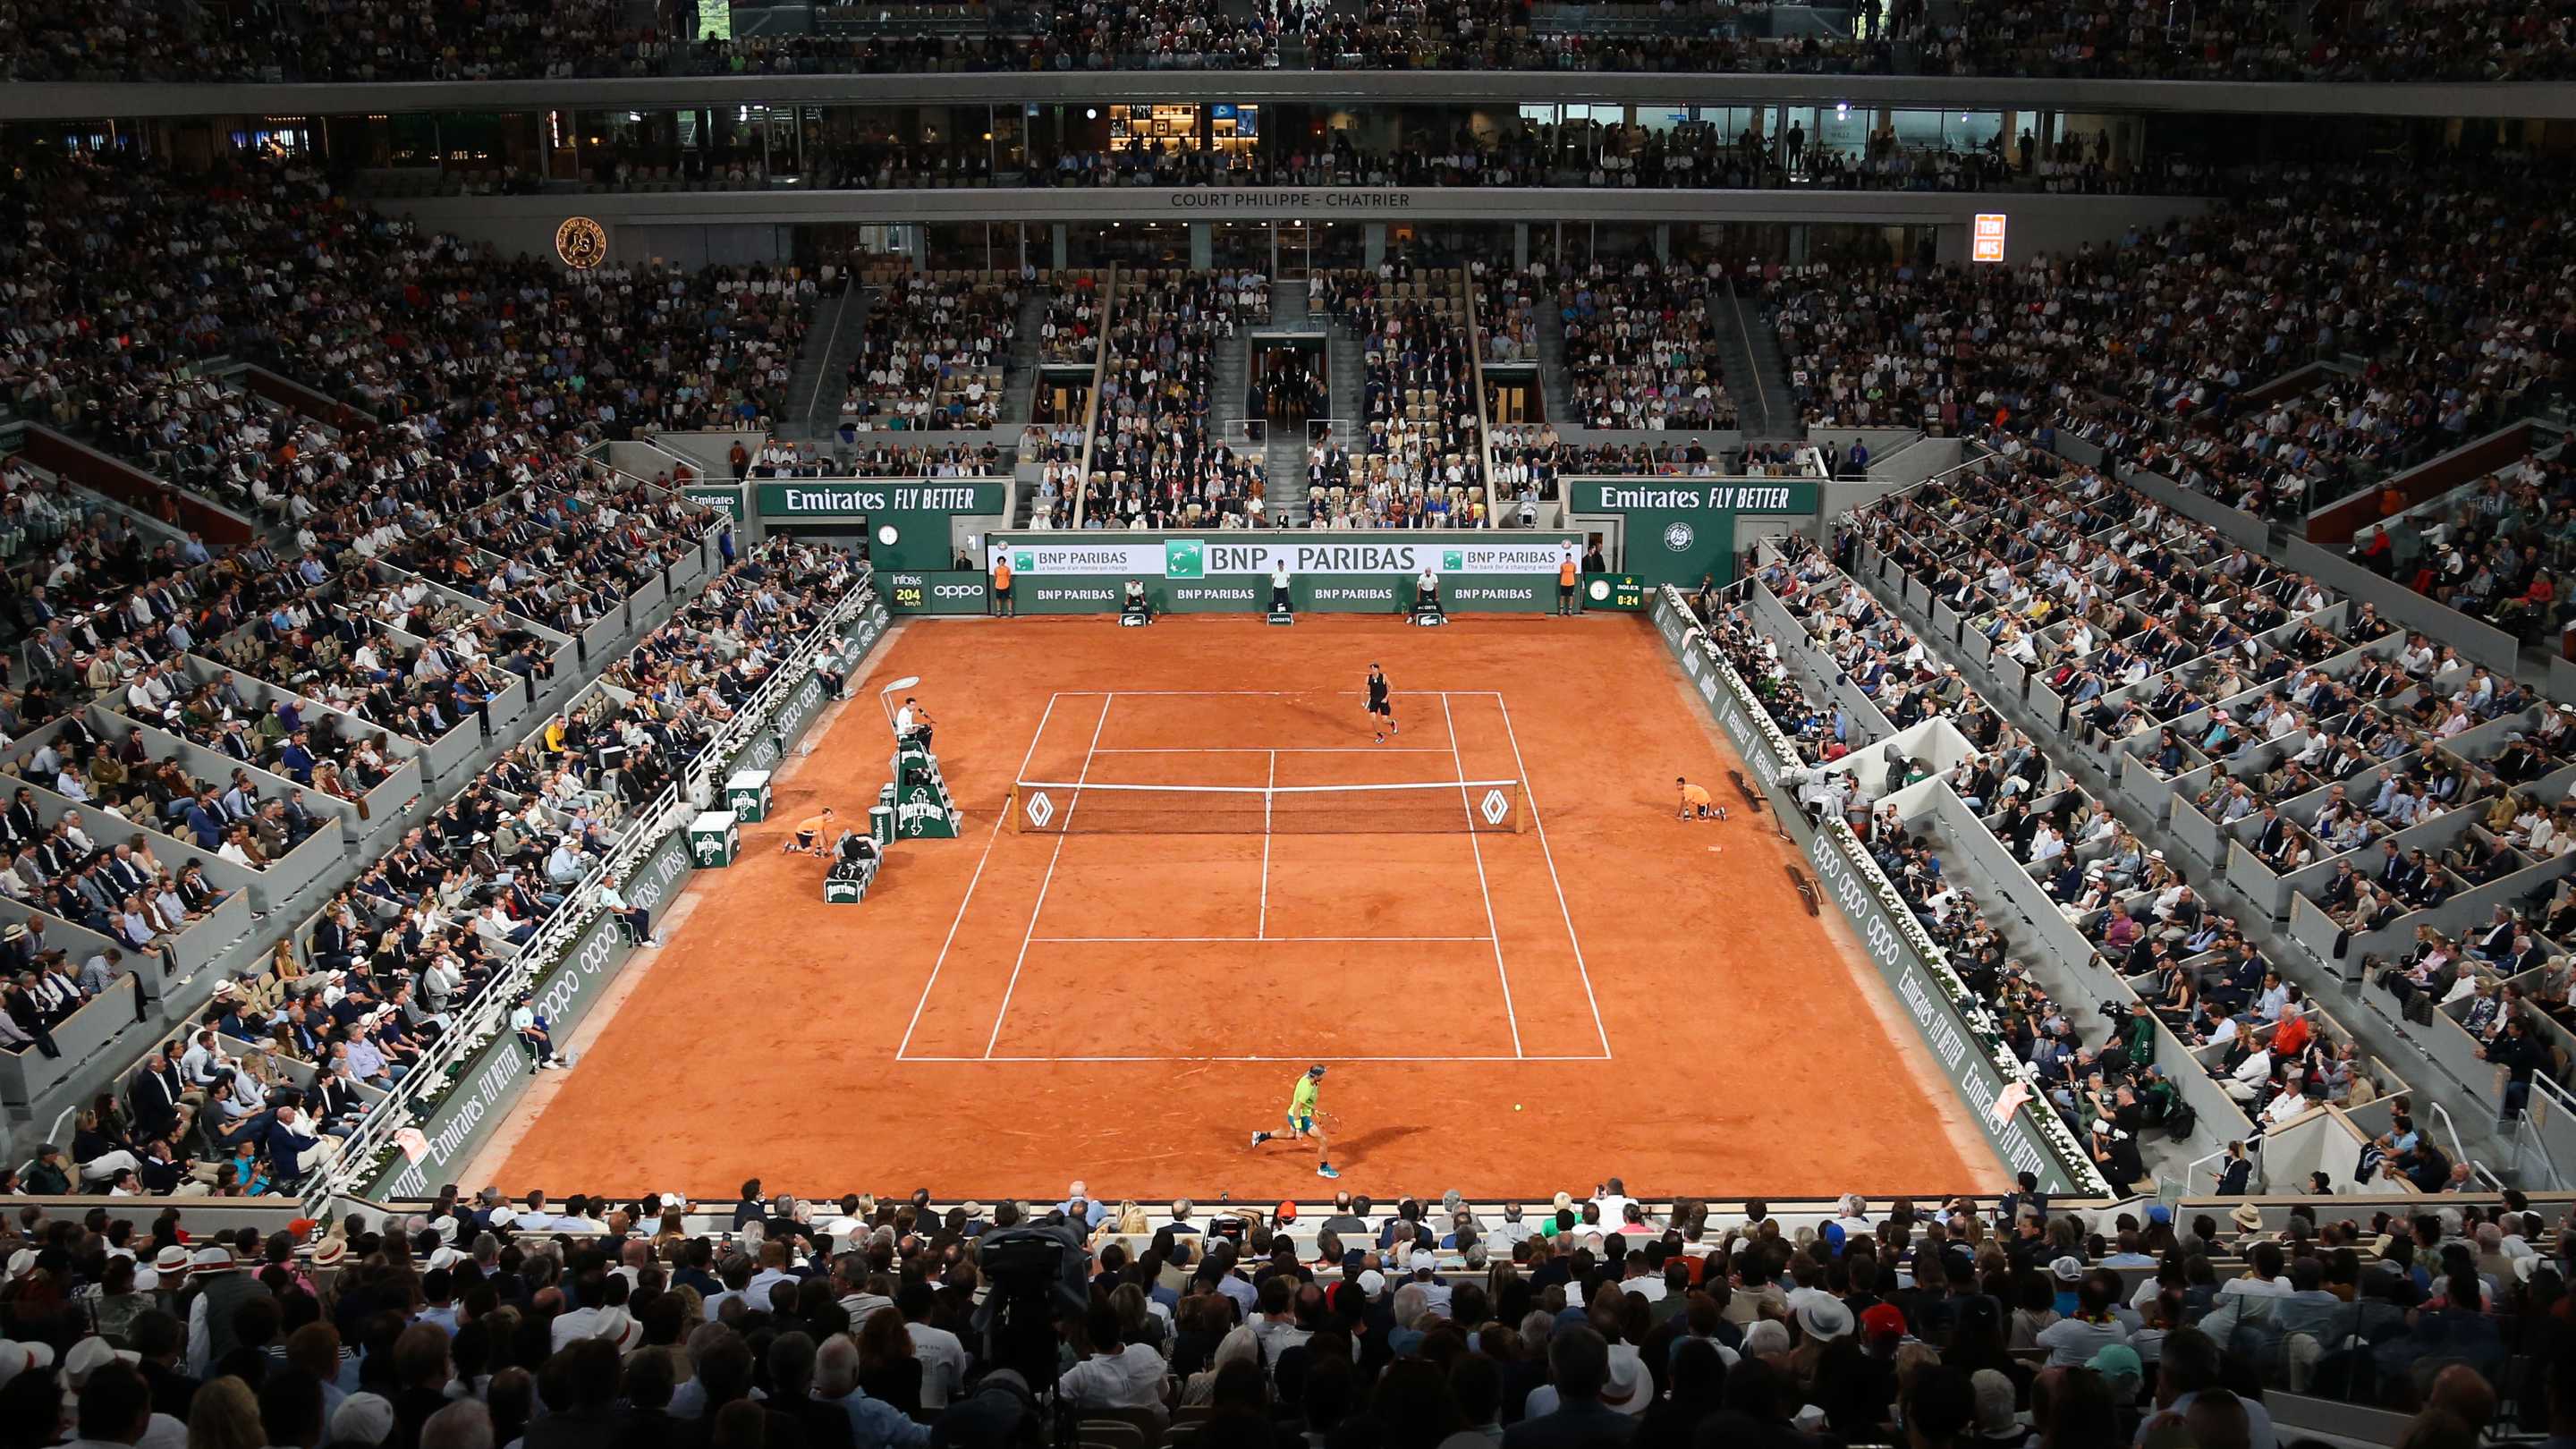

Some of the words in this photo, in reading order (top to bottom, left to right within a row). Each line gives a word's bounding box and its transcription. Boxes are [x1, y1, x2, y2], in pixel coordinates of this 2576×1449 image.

[1171, 193, 1230, 207] COURT
[1234, 193, 1310, 207] PHILIPPE
[1326, 193, 1410, 207] CHATRIER
[691, 495, 734, 505] Emirates
[785, 487, 886, 510] Emirates
[894, 488, 919, 509] FLY
[922, 488, 975, 509] BETTER
[1600, 486, 1699, 508] Emirates
[1707, 487, 1734, 508] FLY
[1736, 487, 1790, 508] BETTER
[1038, 552, 1067, 564] BNP
[1071, 552, 1127, 564] PARIBAS
[1211, 547, 1268, 571] BNP
[1298, 547, 1415, 571] PARIBAS
[1468, 551, 1496, 564] BNP
[1499, 551, 1556, 564] PARIBAS
[893, 574, 922, 586] Infosys
[896, 589, 920, 600] 204
[934, 585, 984, 598] oppo
[1037, 589, 1062, 599] BNP
[1064, 589, 1115, 599] PARIBAS
[1177, 589, 1202, 599] BNP
[1204, 589, 1255, 599] PARIBAS
[1315, 589, 1340, 599] BNP
[1343, 589, 1393, 599] PARIBAS
[1454, 589, 1479, 599] BNP
[1482, 589, 1532, 599] PARIBAS
[1617, 595, 1639, 606] 0:24
[1726, 709, 1750, 745] RENAULT
[1754, 749, 1780, 789] RENAULT
[1813, 835, 1841, 878] oppo
[1838, 872, 1868, 919] oppo
[1867, 914, 1900, 966] oppo
[580, 923, 618, 974] oppo
[1897, 964, 1936, 1029] Emirates
[1937, 1027, 1967, 1072] BETTER
[428, 1094, 485, 1167] Emirates
[490, 1043, 522, 1090] BETTER
